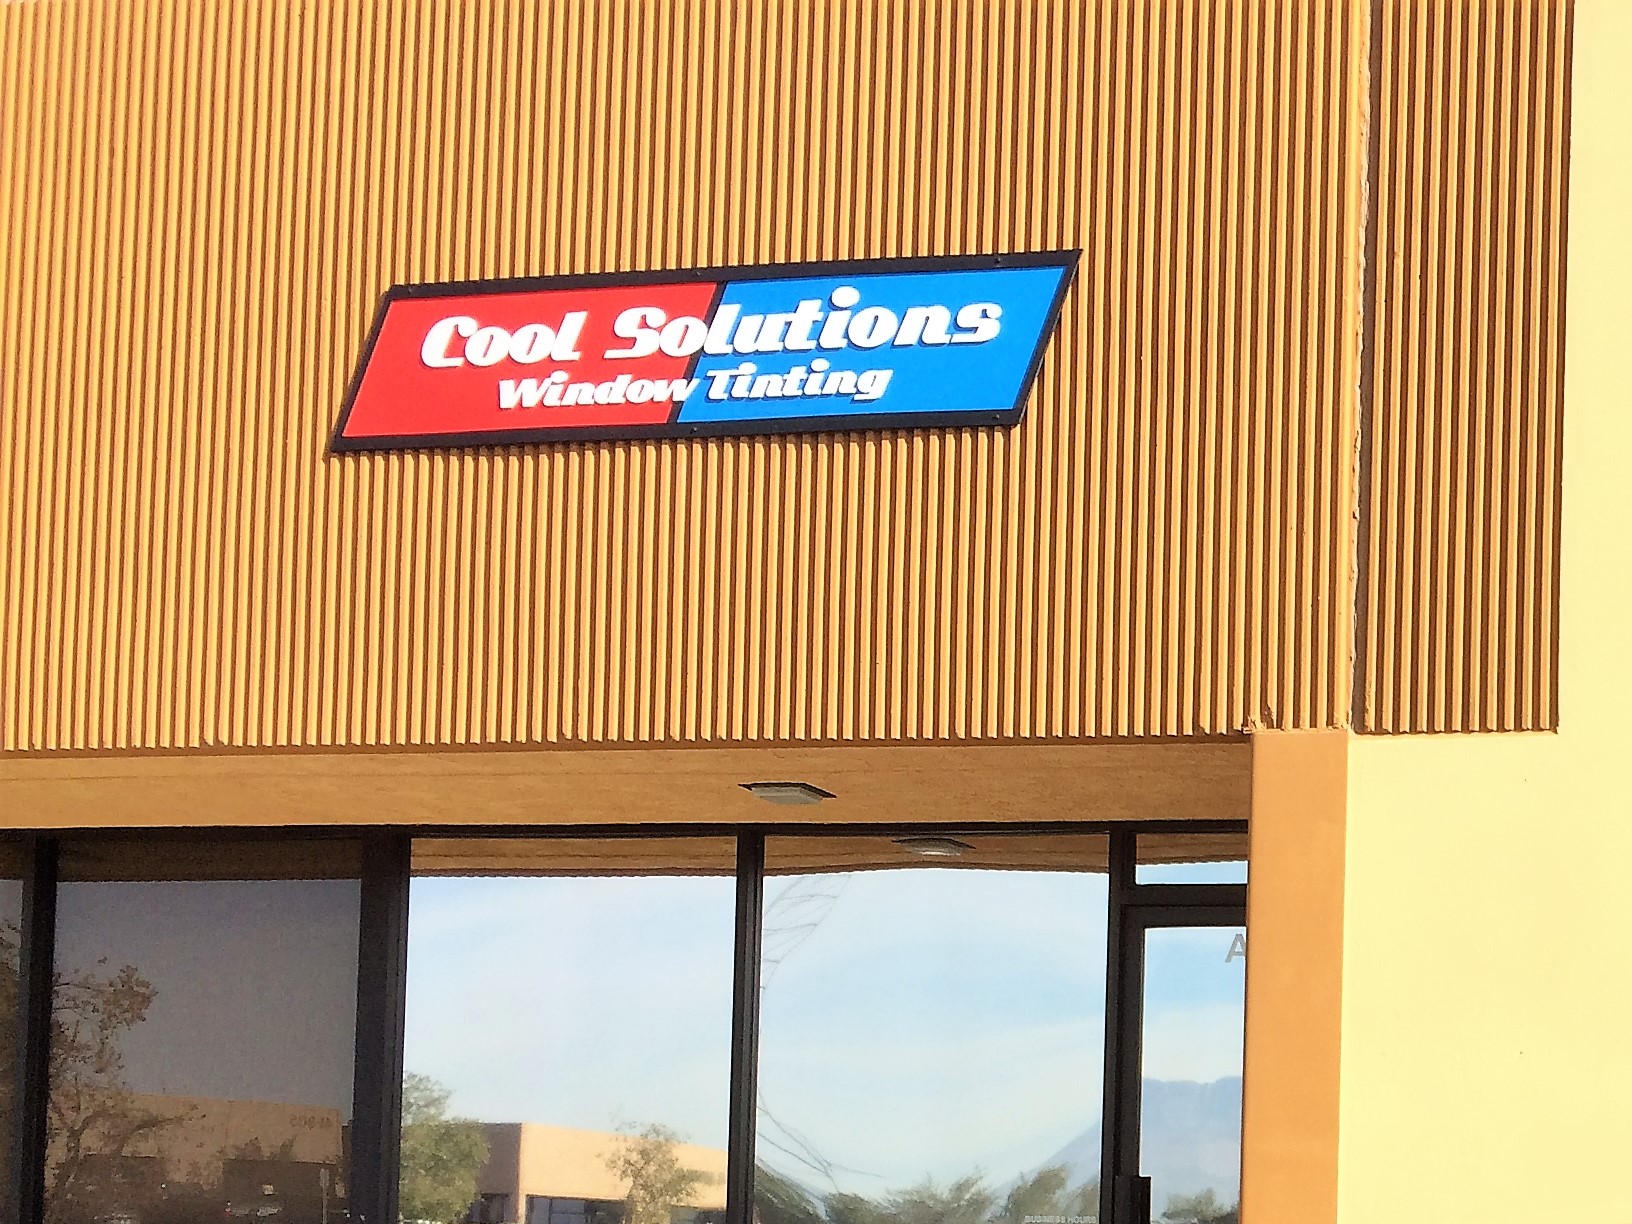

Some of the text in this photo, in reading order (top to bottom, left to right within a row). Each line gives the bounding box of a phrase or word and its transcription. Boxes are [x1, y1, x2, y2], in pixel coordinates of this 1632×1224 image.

[420, 285, 1003, 368] Cool Solutions
[498, 357, 894, 409] Window Tinting
[1024, 1215, 1097, 1224] BUSINESS HOURS
